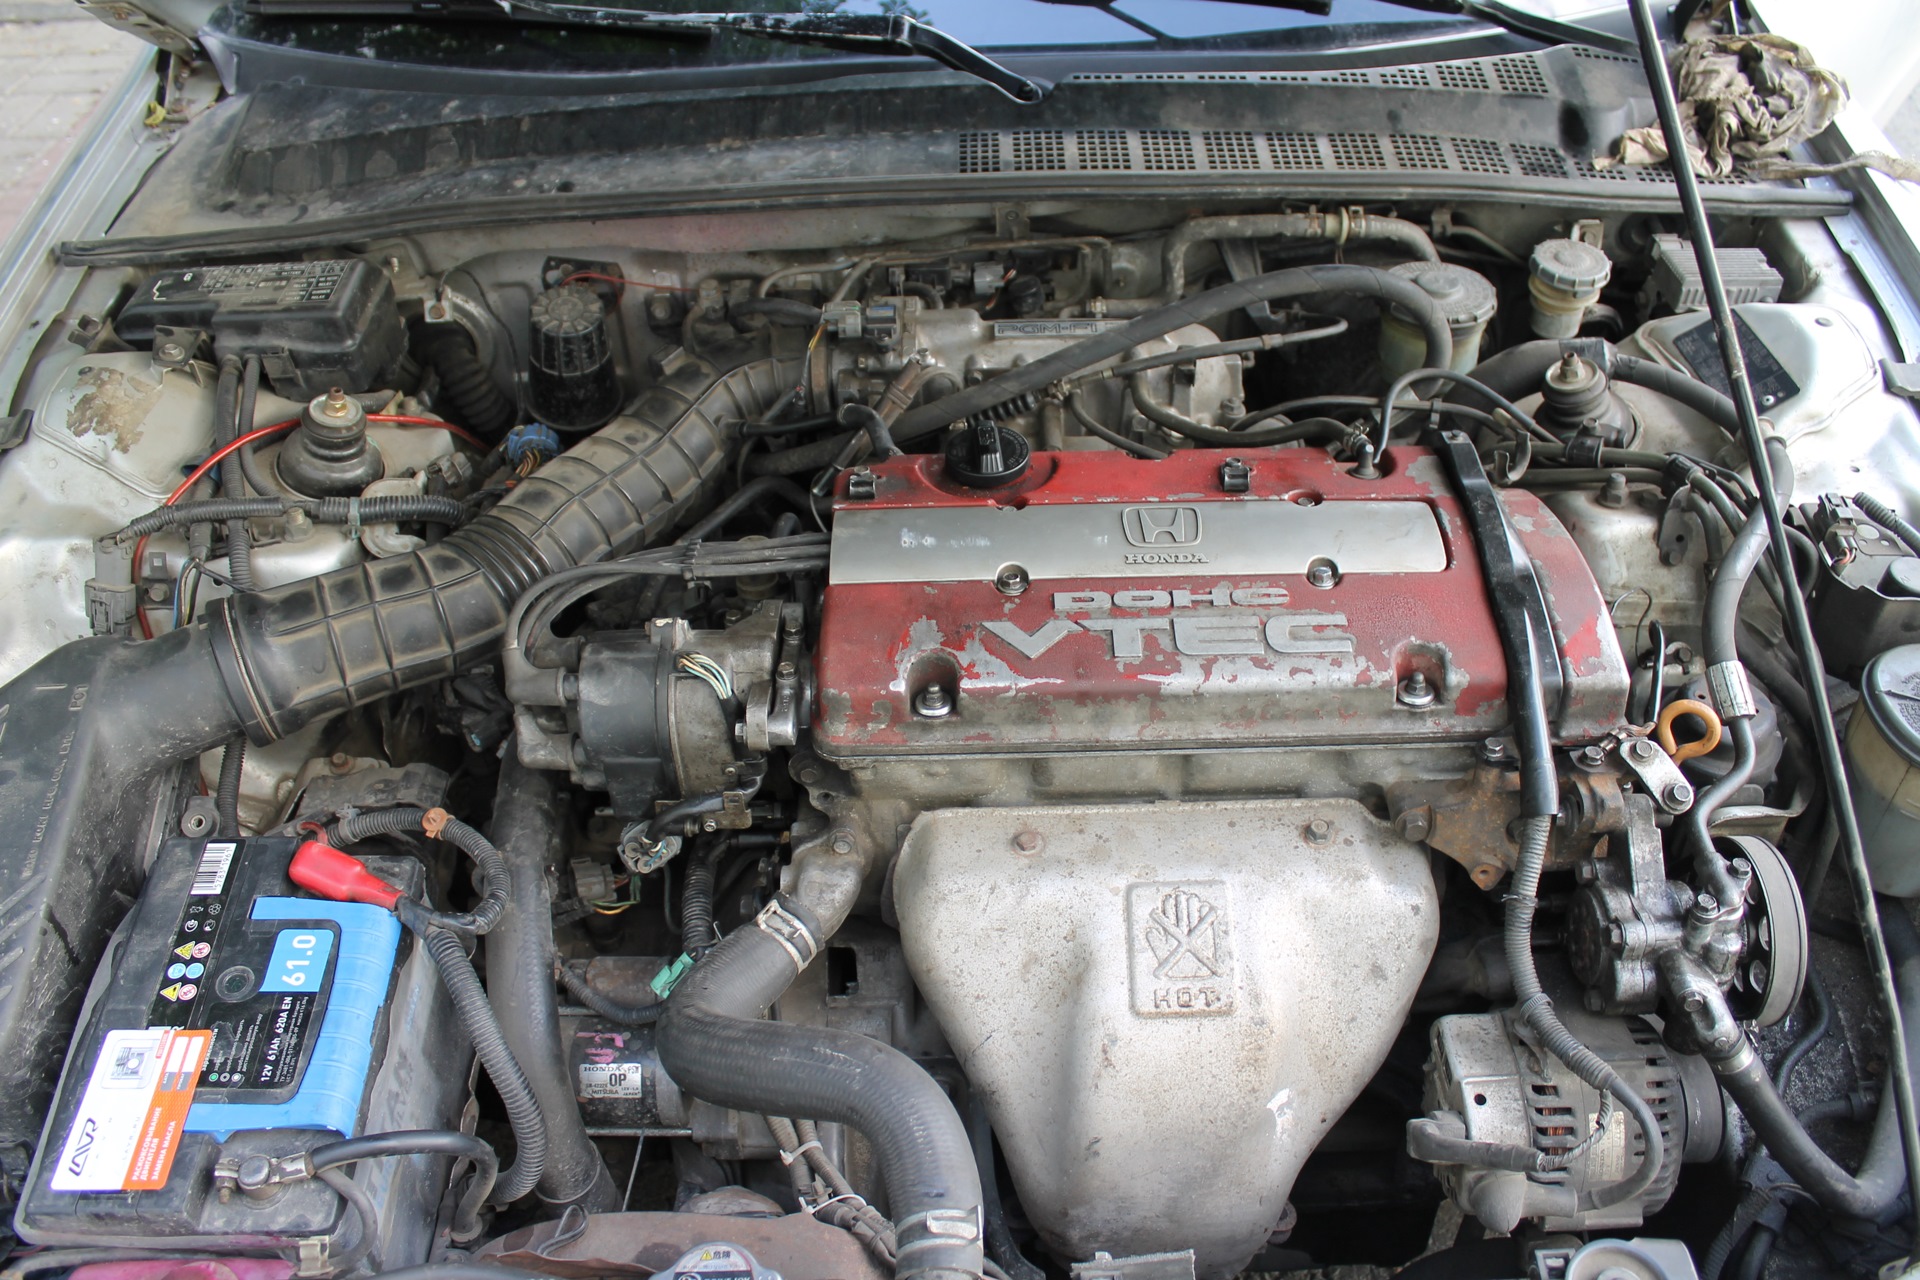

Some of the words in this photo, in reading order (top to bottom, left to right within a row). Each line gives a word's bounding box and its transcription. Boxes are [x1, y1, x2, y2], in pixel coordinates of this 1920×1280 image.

[998, 324, 1098, 335] PGM-FI
[1125, 553, 1210, 564] HONDA
[1054, 588, 1289, 610] DOHC
[981, 615, 1353, 658] VTEC
[282, 935, 317, 986] 61.0
[281, 997, 293, 1009] EN
[274, 1012, 289, 1033] 620A
[267, 1037, 281, 1060] 61Ah
[261, 1064, 273, 1081] 12V
[609, 1073, 627, 1087] OP
[67, 1117, 98, 1177] LAVR
[132, 1107, 162, 1180] РАСКОКСОВЫВАНИЕ
[150, 1150, 168, 1180] ЗАМЕНА
[162, 1121, 177, 1148] МАСЛА
[140, 1137, 159, 1180] ДВИГАТЕЛЯ
